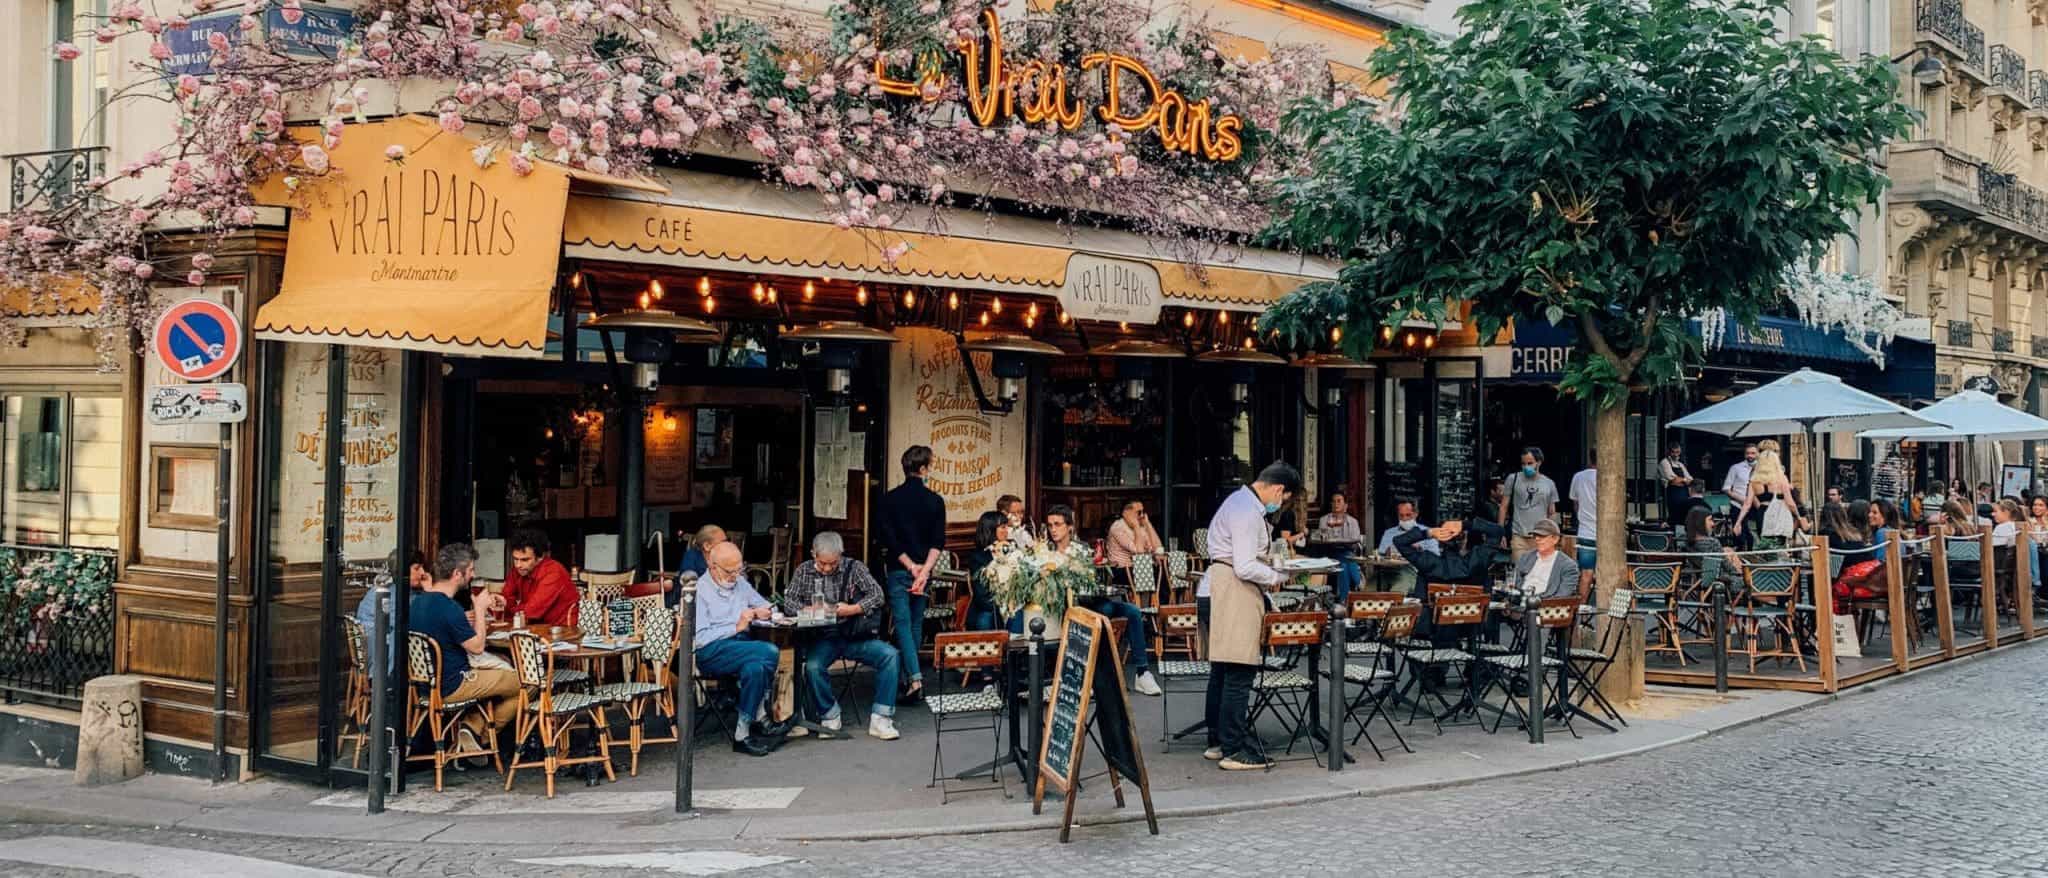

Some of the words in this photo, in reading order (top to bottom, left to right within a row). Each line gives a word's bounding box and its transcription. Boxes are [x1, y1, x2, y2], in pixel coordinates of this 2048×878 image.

[329, 170, 404, 255] VRAI
[420, 168, 516, 256] PARIS
[645, 217, 693, 241] CAFÉ
[371, 259, 457, 282] Montmartre
[1072, 263, 1107, 303] VRAI
[1113, 264, 1152, 307] PARIS
[1736, 322, 1746, 344] LE
